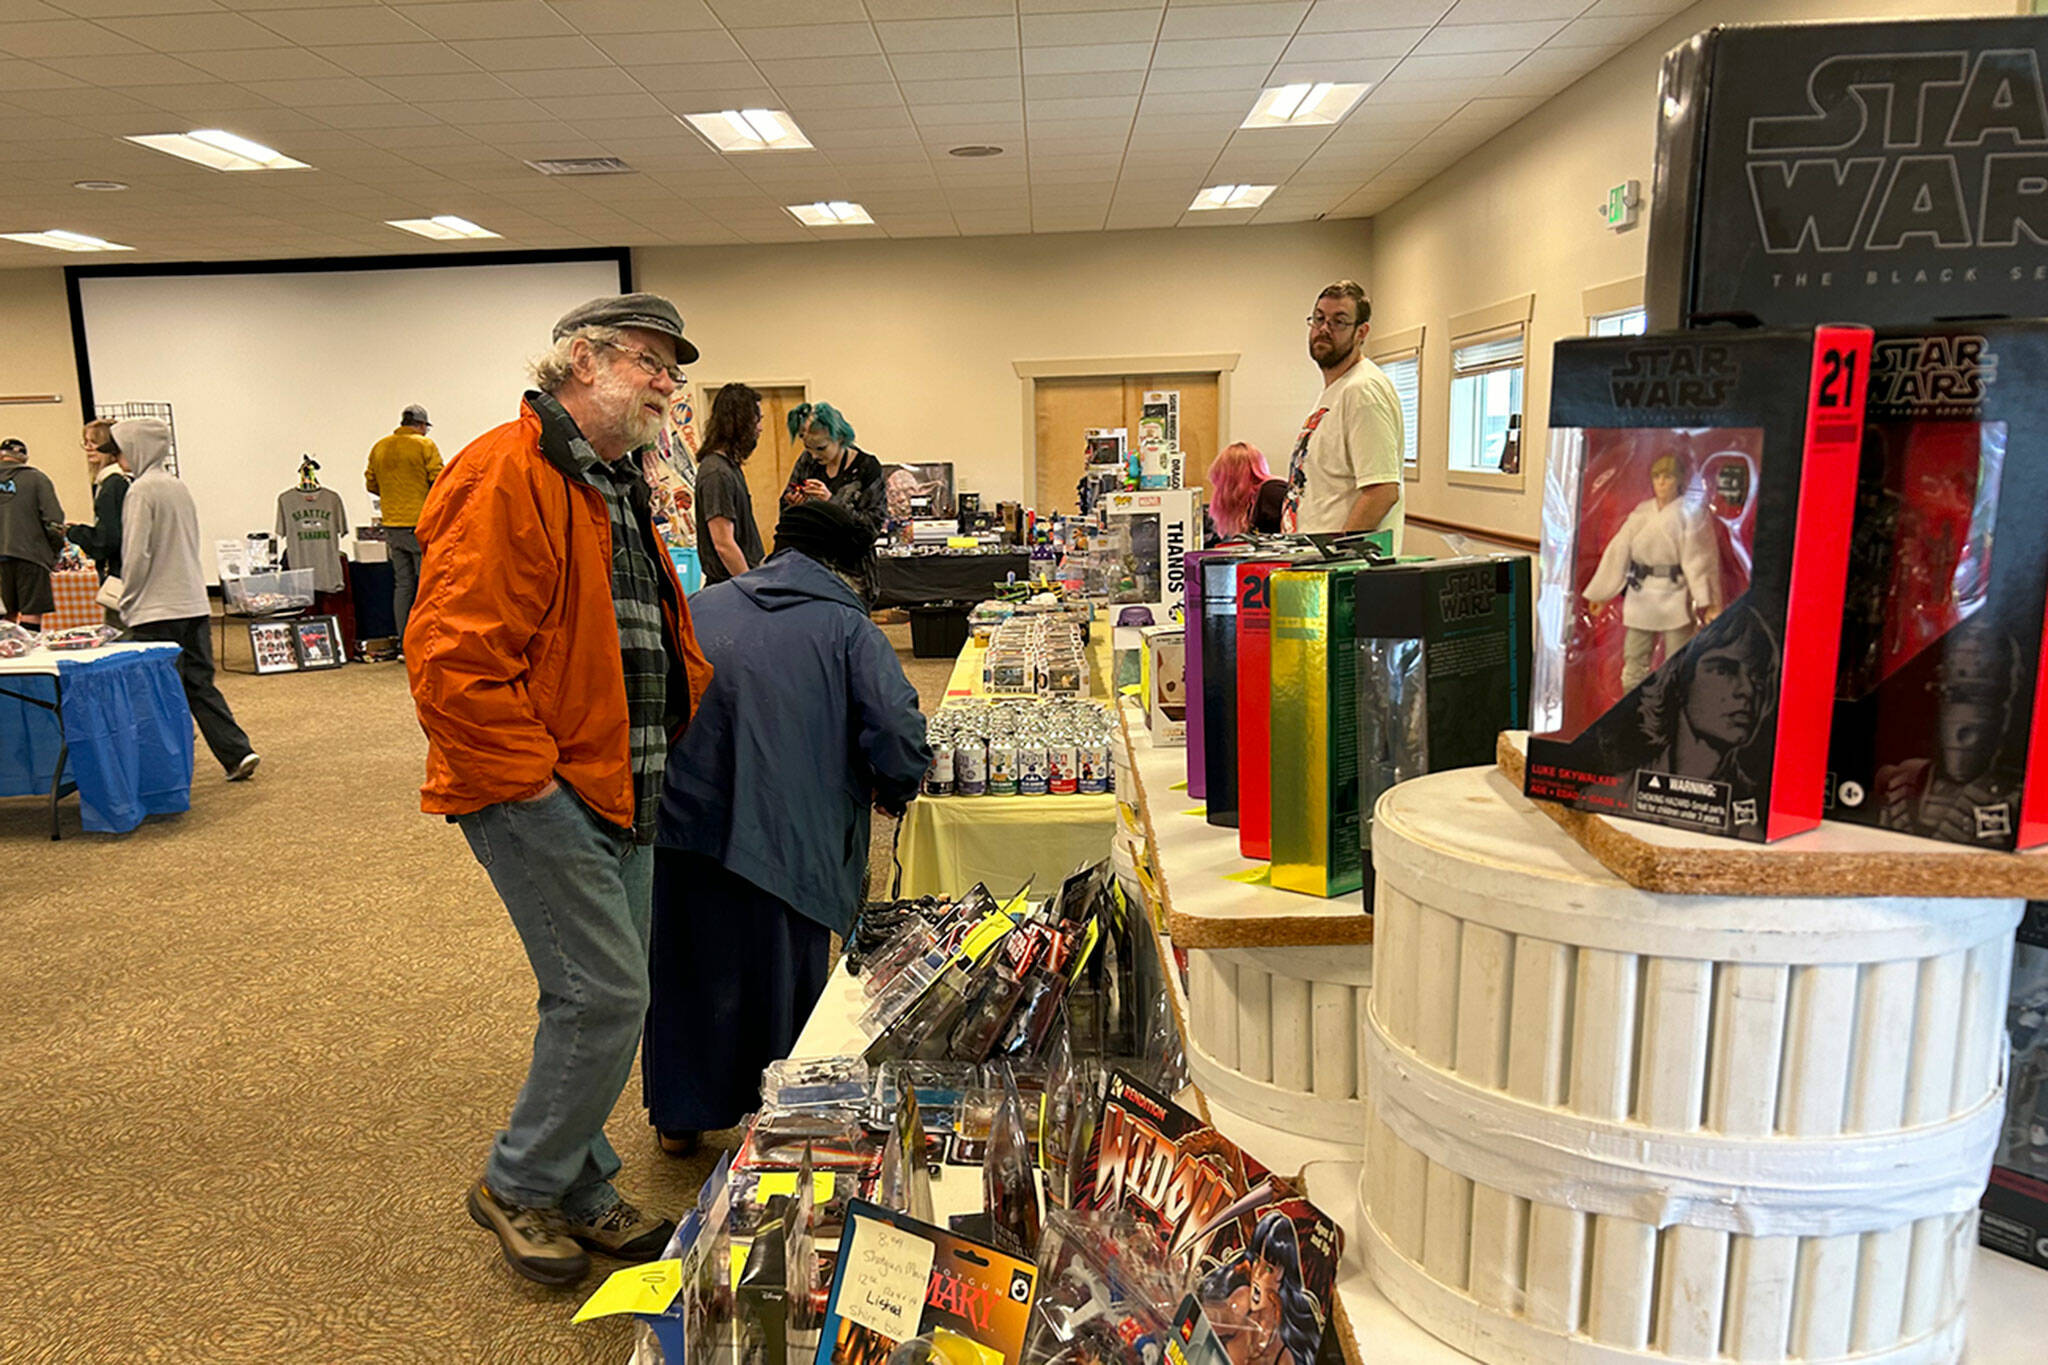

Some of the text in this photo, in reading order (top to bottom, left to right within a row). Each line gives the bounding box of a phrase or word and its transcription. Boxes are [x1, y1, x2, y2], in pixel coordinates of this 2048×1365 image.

[1746, 48, 2048, 154] STA
[1746, 152, 2048, 254] WAR
[1773, 273, 1833, 287] THE
[1866, 267, 1977, 285] BLACK
[1611, 347, 1740, 377] STAR
[1872, 335, 1999, 370] STAR
[1610, 377, 1737, 411] WARS
[1818, 349, 1857, 408] 21
[292, 508, 331, 521] SEATTLE
[1167, 521, 1185, 593] THANOS
[1531, 764, 1555, 777] LUKE
[1669, 778, 1717, 798] WARNING:
[1123, 1084, 1169, 1121] RENDITION
[933, 1264, 1004, 1297] OTGUN
[923, 1270, 1001, 1332] MARY
